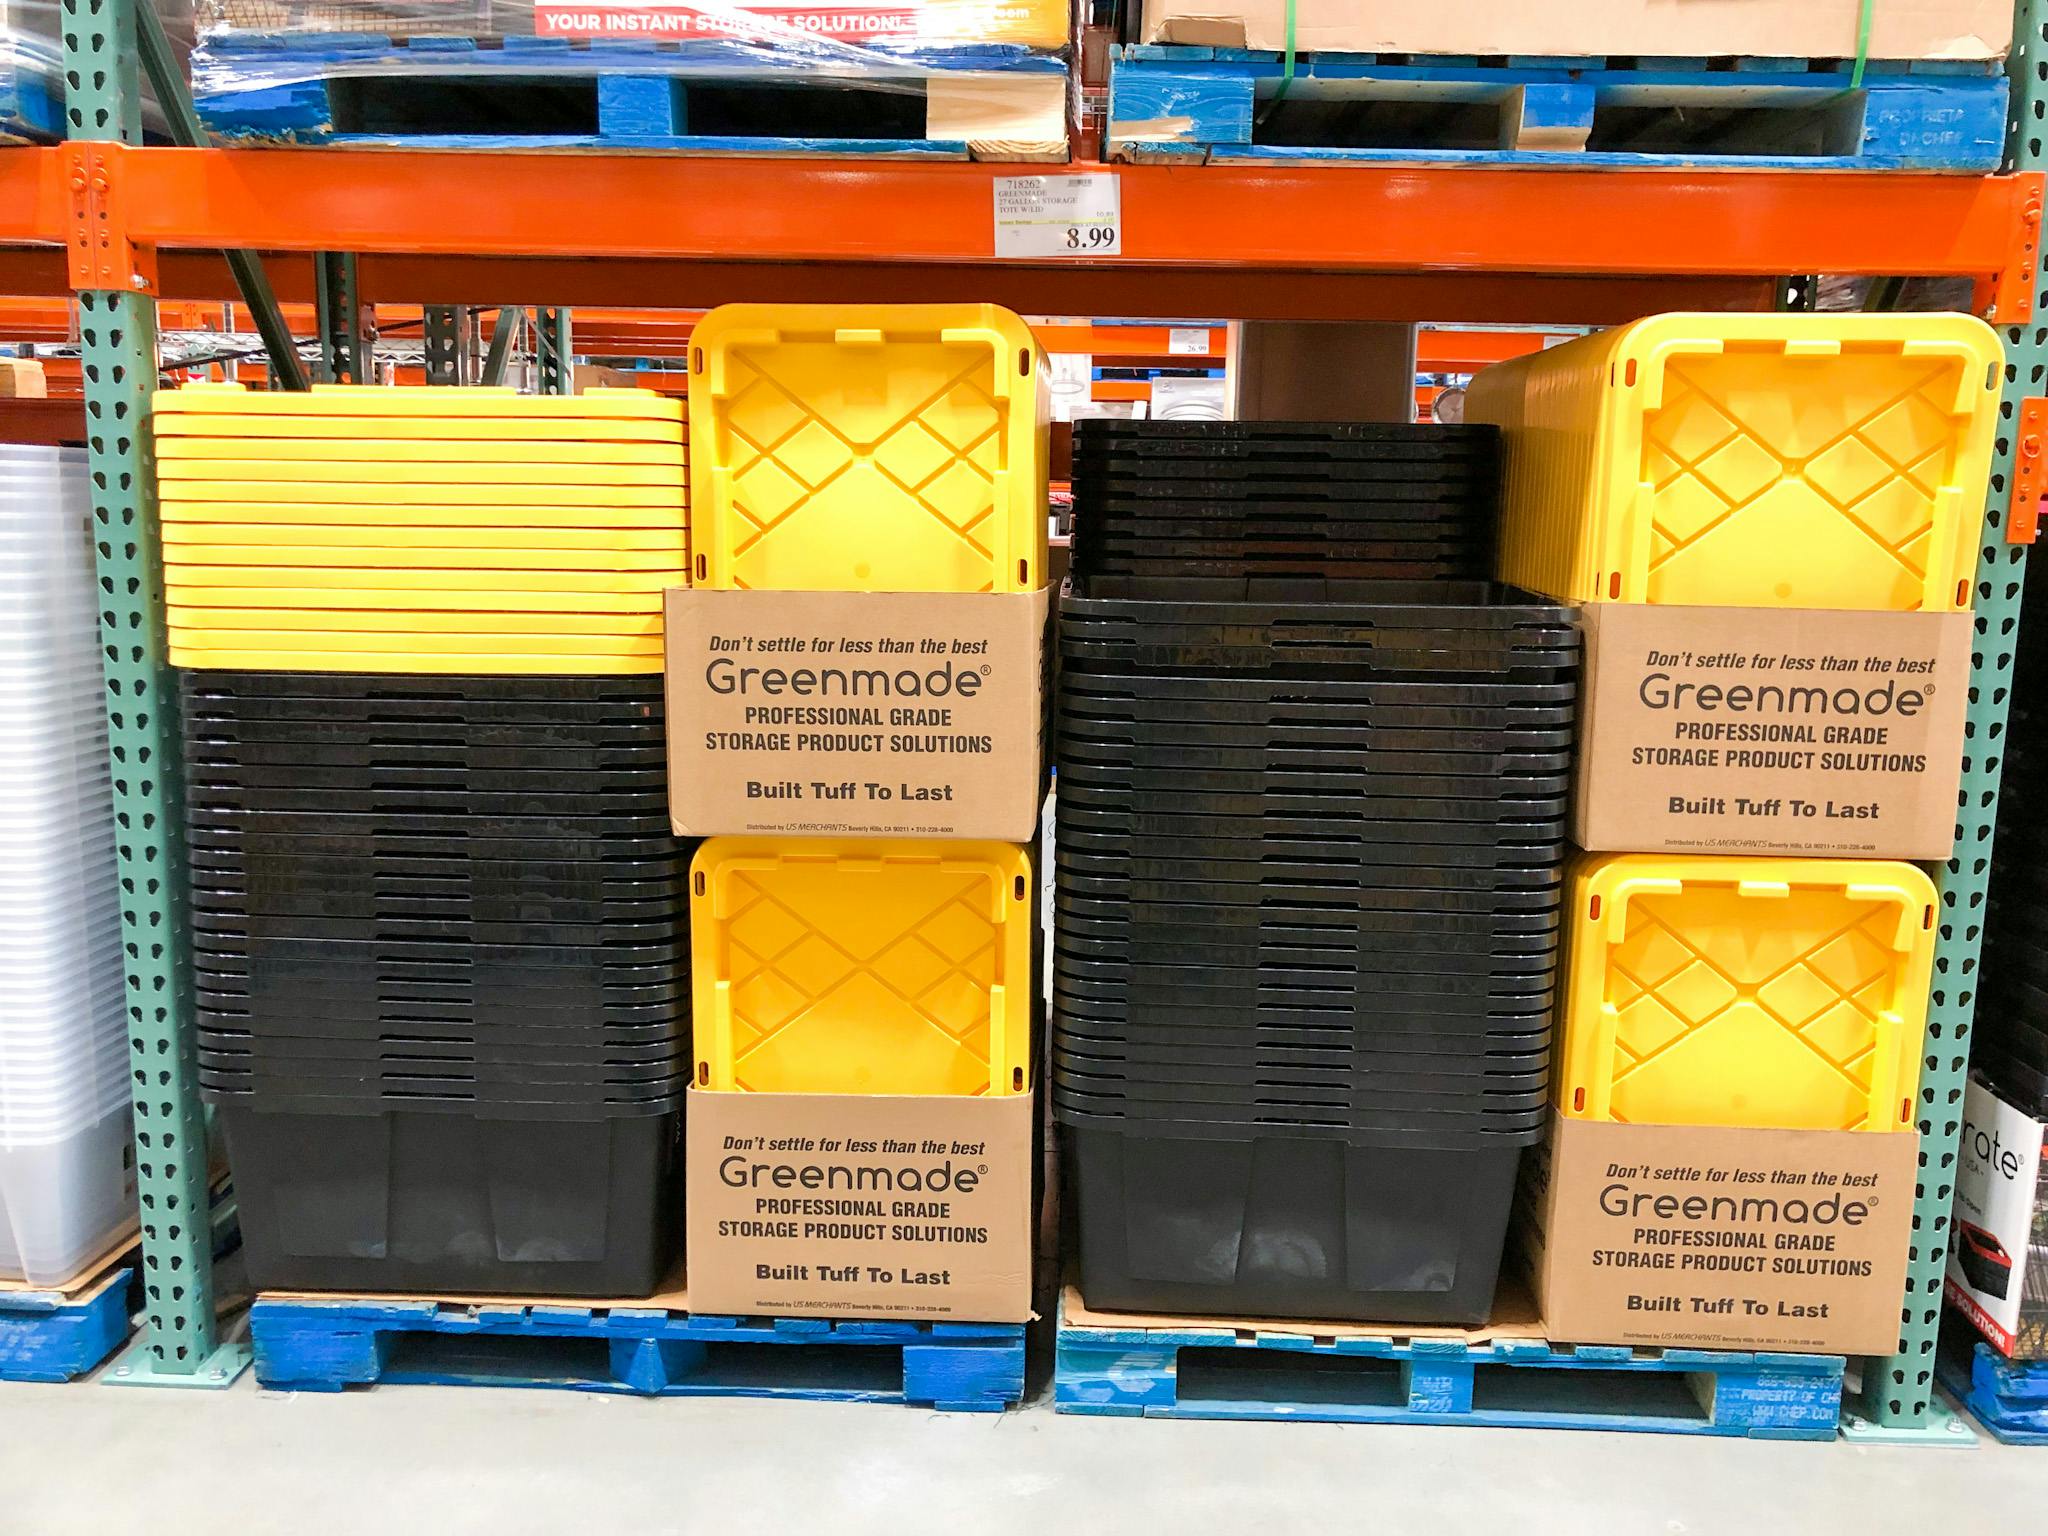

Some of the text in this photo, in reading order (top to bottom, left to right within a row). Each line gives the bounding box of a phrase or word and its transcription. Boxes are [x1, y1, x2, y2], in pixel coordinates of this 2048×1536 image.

[546, 14, 600, 30] YOUR
[606, 15, 690, 31] INSTANT
[998, 190, 1047, 198] GREENMADE
[1007, 180, 1041, 189] 718262
[1066, 227, 1115, 249] 8.99
[710, 636, 988, 654] Don't settle for less than the best
[1647, 651, 1935, 673] Don't settle for less than the best
[746, 707, 951, 726] PROFESSIONAL GRADE
[706, 733, 991, 753] STORAGE PRODUCT SOLUTIONS
[1676, 722, 1888, 744] PROFESSIONAL GRADE
[1632, 747, 1926, 772] STORAGE PRODUCT SOLUTIONS
[747, 782, 952, 800] Built Tuff To Last
[1669, 797, 1879, 818] Built Tuff To Last
[798, 823, 848, 832] MERCHANTS
[724, 1136, 985, 1155] Don't settle for less than the best
[1607, 1164, 1878, 1186] Don't settle for less than the best
[757, 1198, 949, 1218] PROFESSIONAL GRADE
[719, 1221, 987, 1243] STORAGE PRODUCT SOLUTIONS
[1634, 1229, 1835, 1251] PROFESSIONAL GRADE
[1593, 1250, 1872, 1276] STORAGE PRODUCT SOLUTIONS
[757, 1264, 950, 1285] Built Tuff To Last
[1628, 1296, 1828, 1318] Built Tuff To Last
